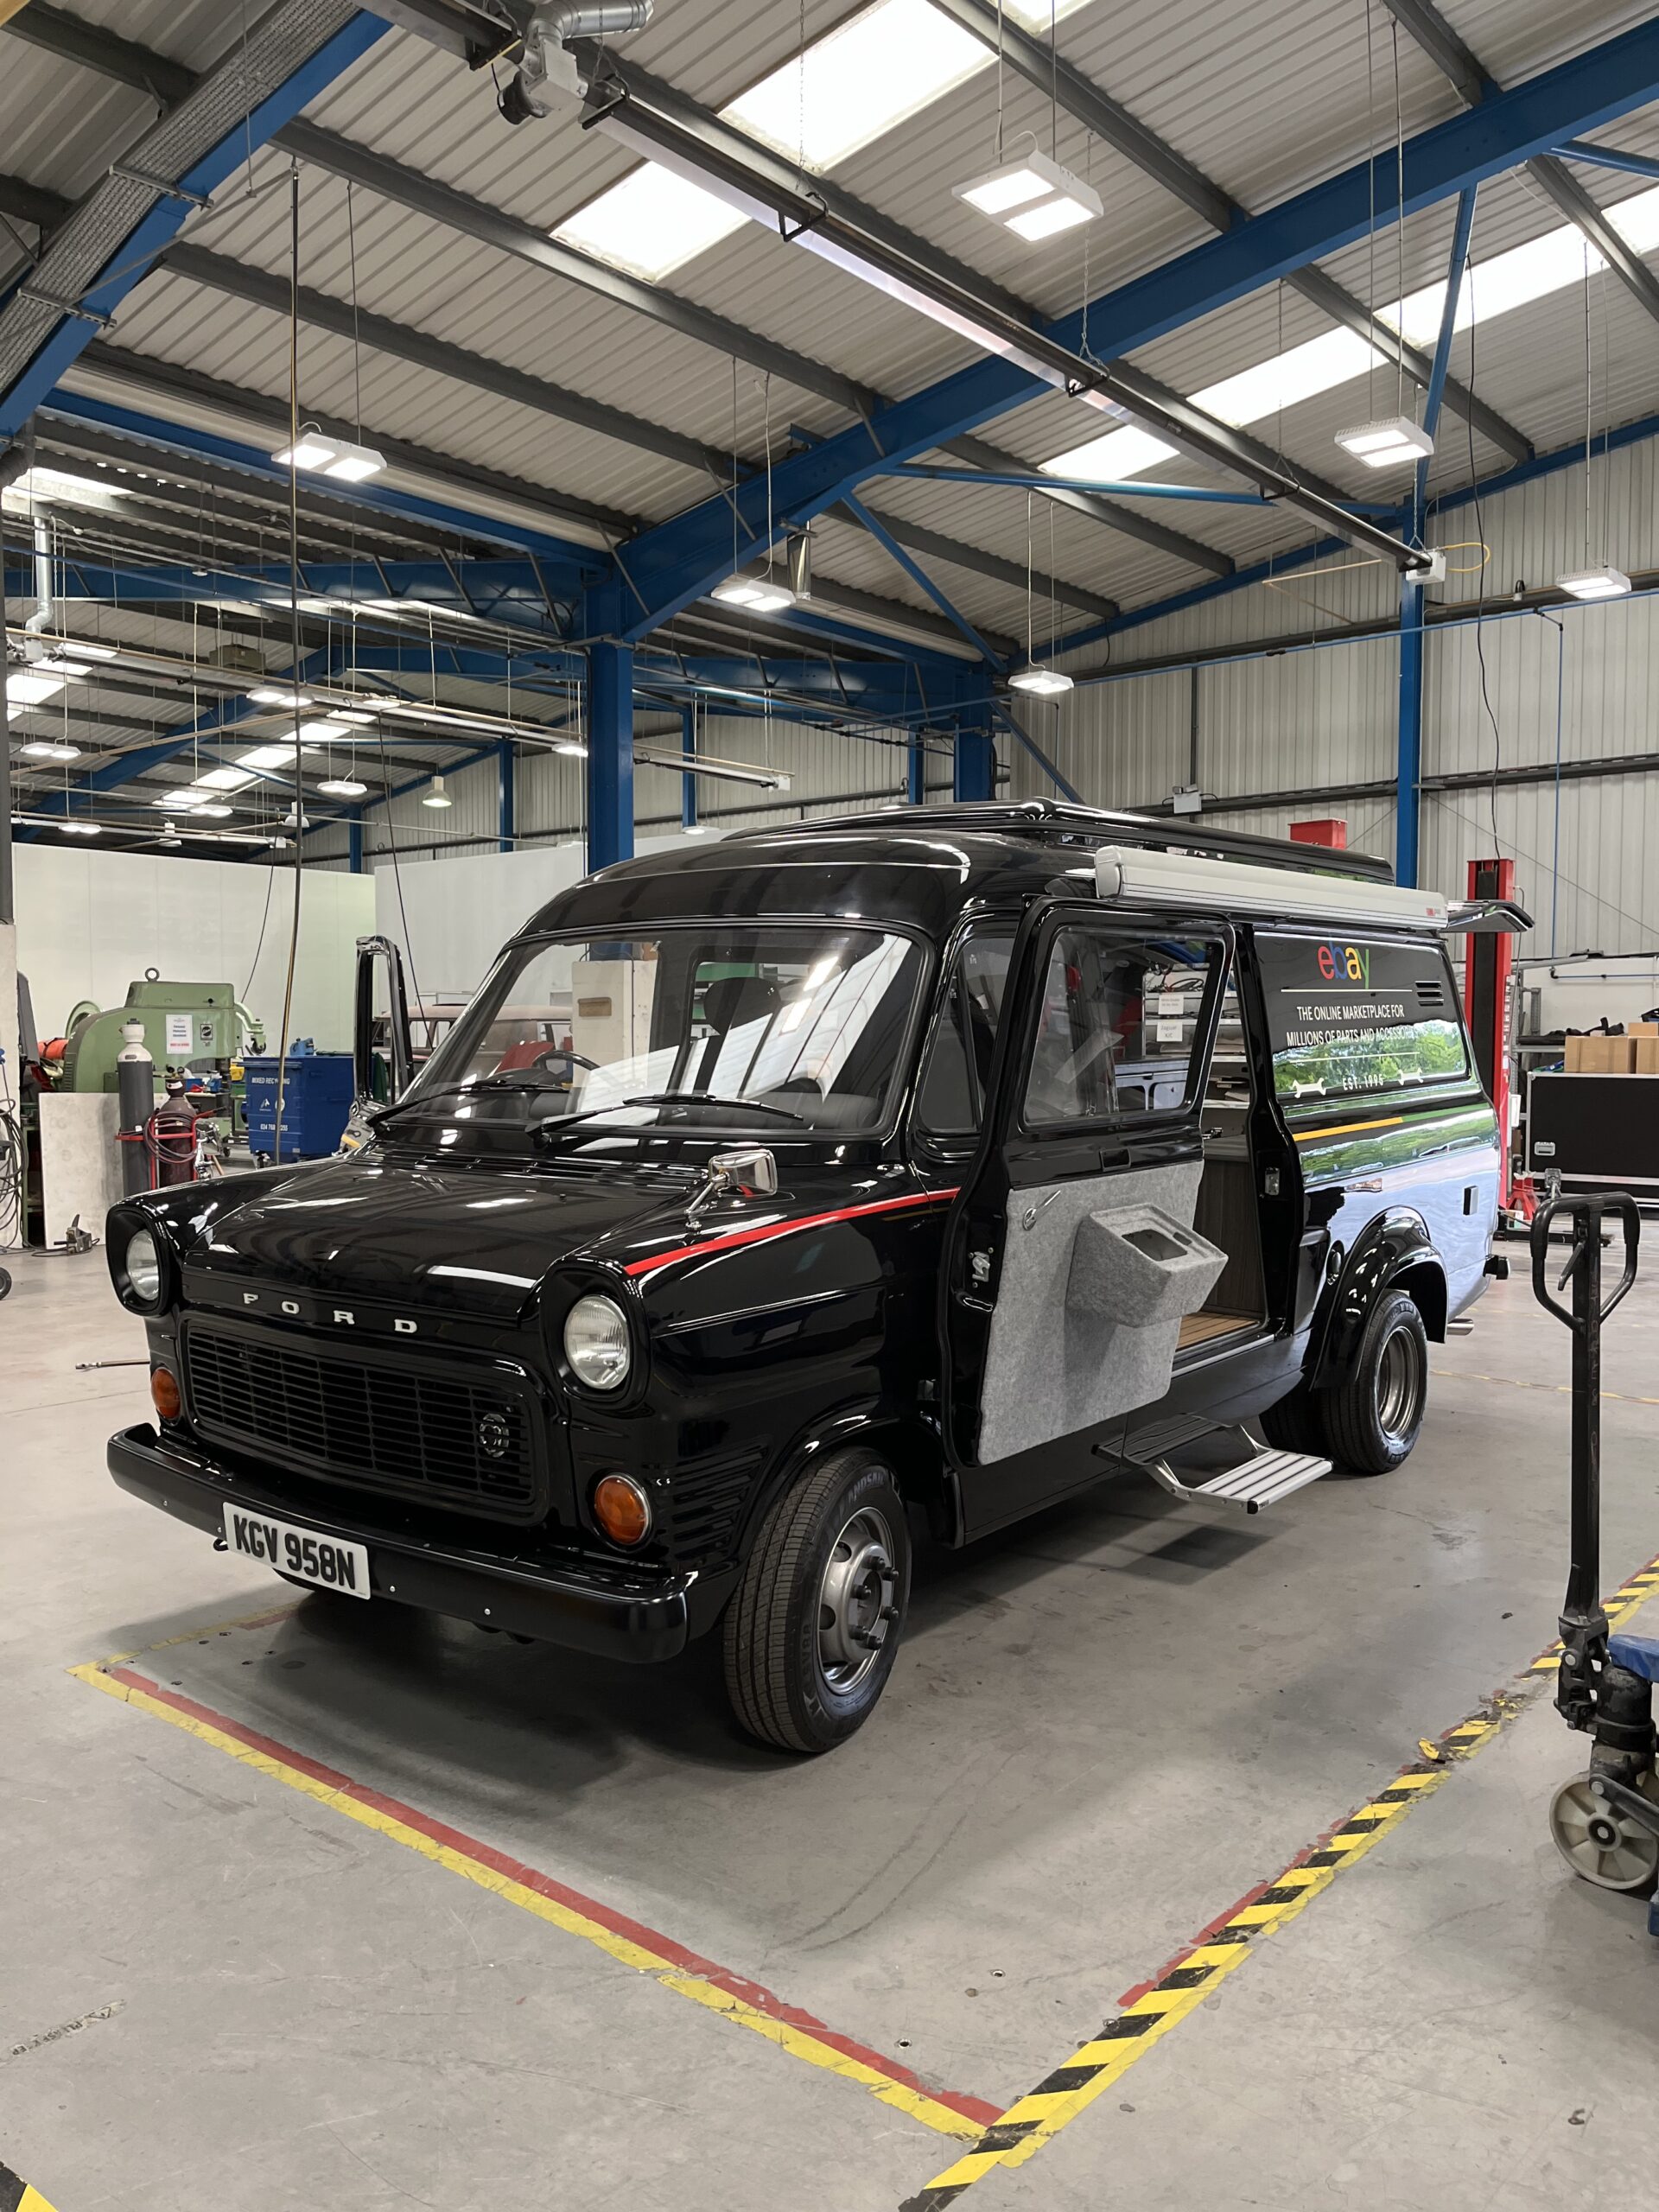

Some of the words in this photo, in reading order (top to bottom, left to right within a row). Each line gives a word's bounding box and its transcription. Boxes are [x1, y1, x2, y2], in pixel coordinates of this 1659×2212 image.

[1318, 941, 1369, 989] ebay
[1297, 1007, 1313, 1020] THE
[1314, 1006, 1342, 1020] ONLINE
[1342, 1005, 1391, 1020] MARKETPLACE
[1391, 1004, 1405, 1018] FOR
[1287, 1031, 1325, 1046] MILLIONS
[1325, 1031, 1336, 1045] OF
[1337, 1029, 1359, 1043] PARTS
[1359, 1027, 1375, 1042] AND
[1343, 1077, 1362, 1090] EST.
[1364, 1074, 1384, 1089] 1995
[243, 1293, 417, 1333] FORD
[233, 1514, 277, 1562] KGV
[284, 1533, 355, 1590] 958N
